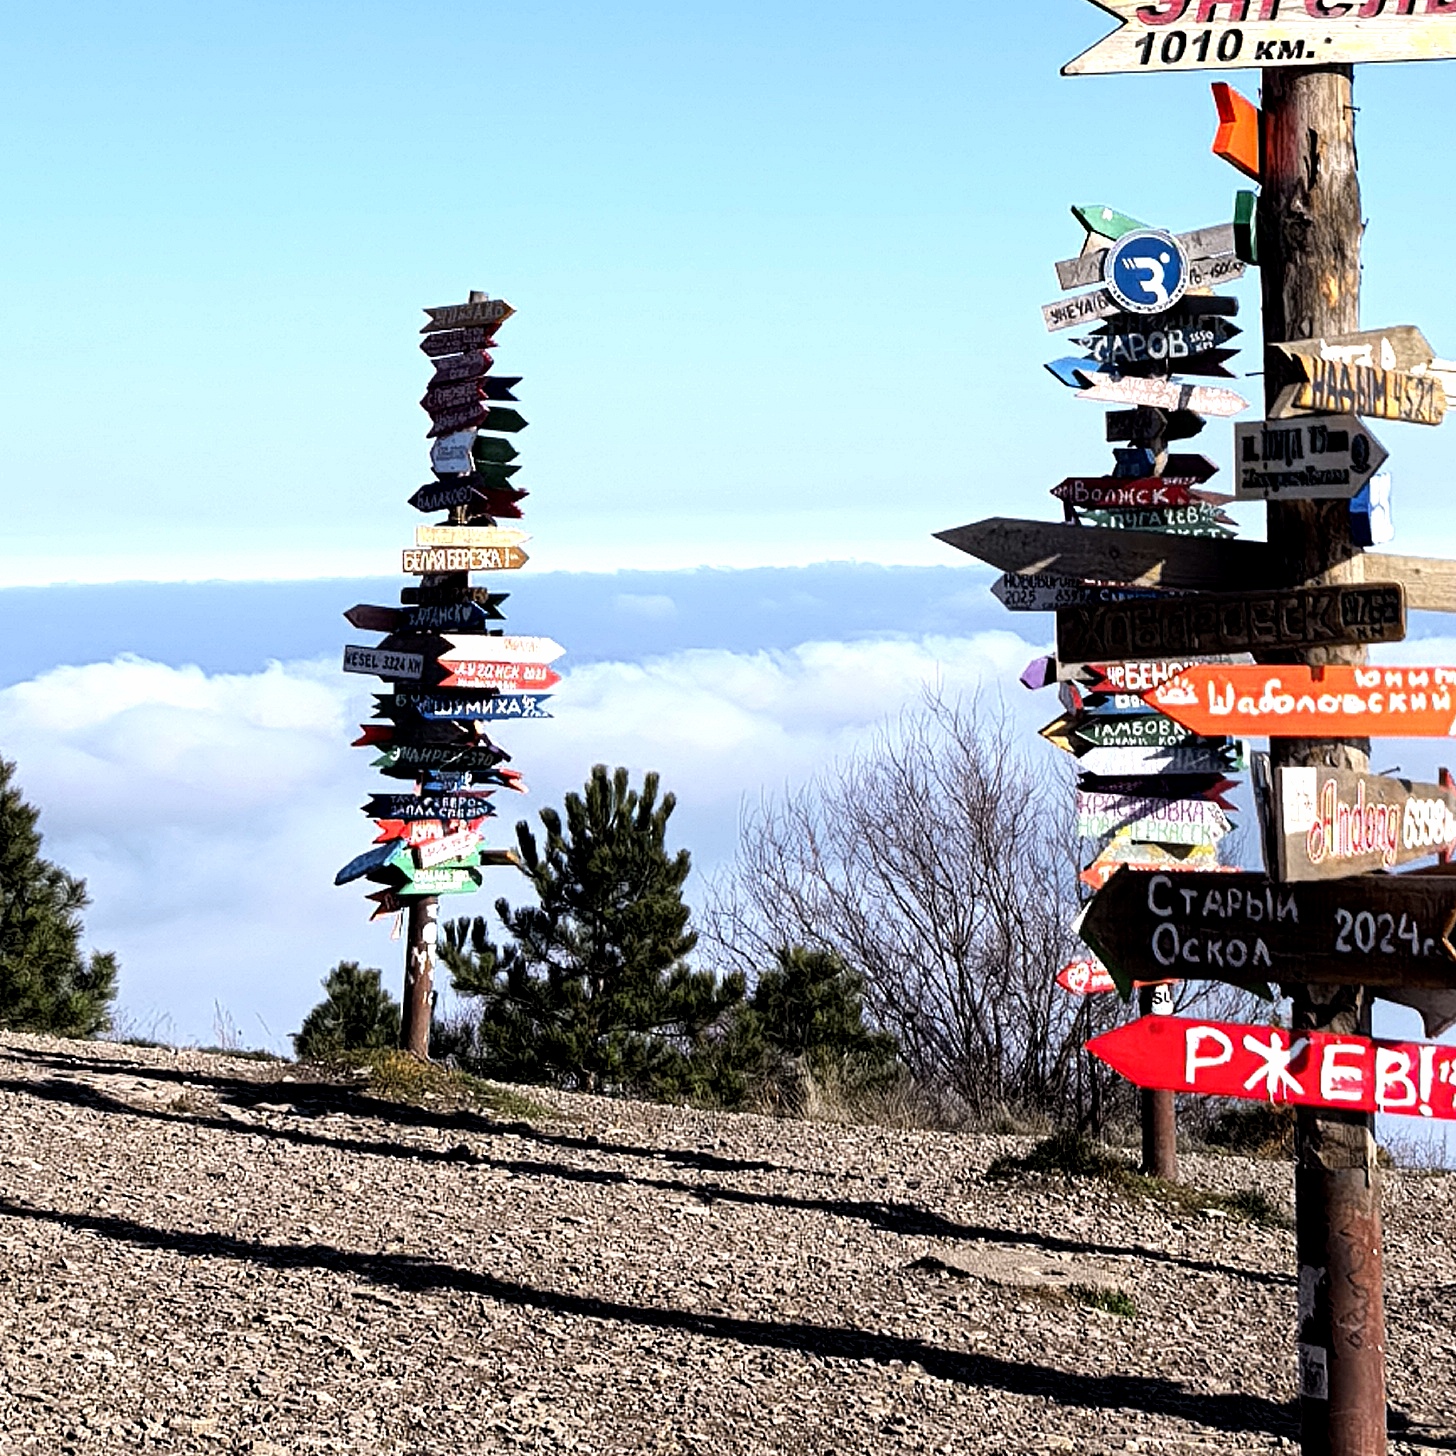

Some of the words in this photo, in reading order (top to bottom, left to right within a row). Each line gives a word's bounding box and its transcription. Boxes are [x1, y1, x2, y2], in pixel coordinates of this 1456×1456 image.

[1134, 28, 1243, 66] 1010
[1094, 329, 1189, 363] САРОВ
[403, 550, 446, 572] БЕЛАЯ
[447, 547, 502, 570] БЕРЕЗКА
[1307, 778, 1401, 868] Andong
[1184, 1025, 1437, 1117] РЖЕВ!
